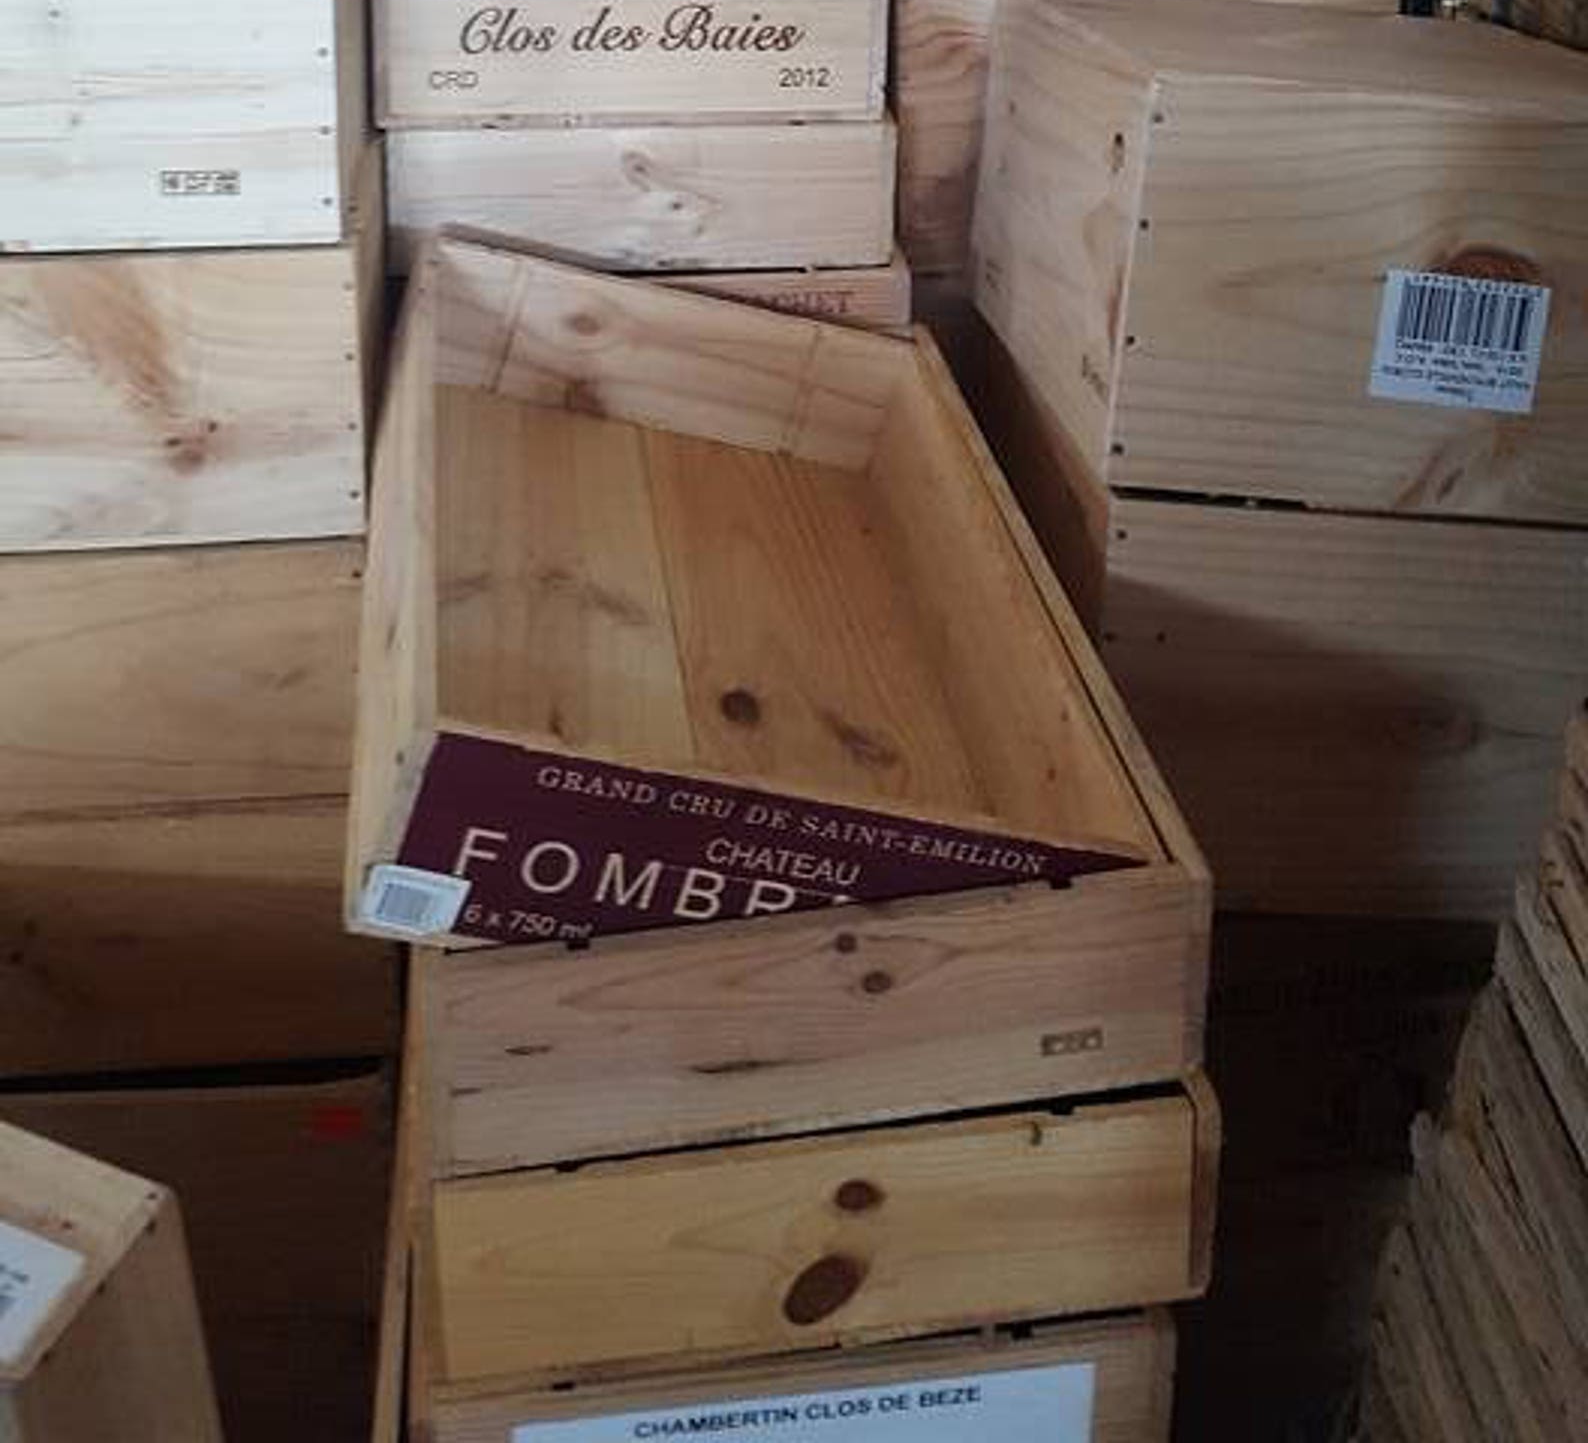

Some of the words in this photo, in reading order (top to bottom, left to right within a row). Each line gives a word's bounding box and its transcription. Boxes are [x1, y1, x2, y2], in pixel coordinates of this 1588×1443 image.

[459, 6, 557, 55] Clos
[570, 6, 652, 53] des
[658, 2, 805, 53] Baies
[428, 70, 479, 91] CRD
[778, 67, 832, 89] 2012
[537, 766, 657, 805] GRAND
[669, 789, 735, 819] CRU
[745, 804, 792, 831] DE
[801, 814, 1049, 875] SAINT-EMILION
[454, 825, 852, 920] FOMBR
[705, 837, 861, 887] CHATEAU
[463, 905, 482, 924] 6
[488, 913, 501, 928] x
[508, 909, 556, 937] 750
[633, 1407, 798, 1439] CHAMBERTIN
[804, 1398, 871, 1422] CLOS
[877, 1393, 909, 1413] DE
[918, 1385, 983, 1409] BEZE
